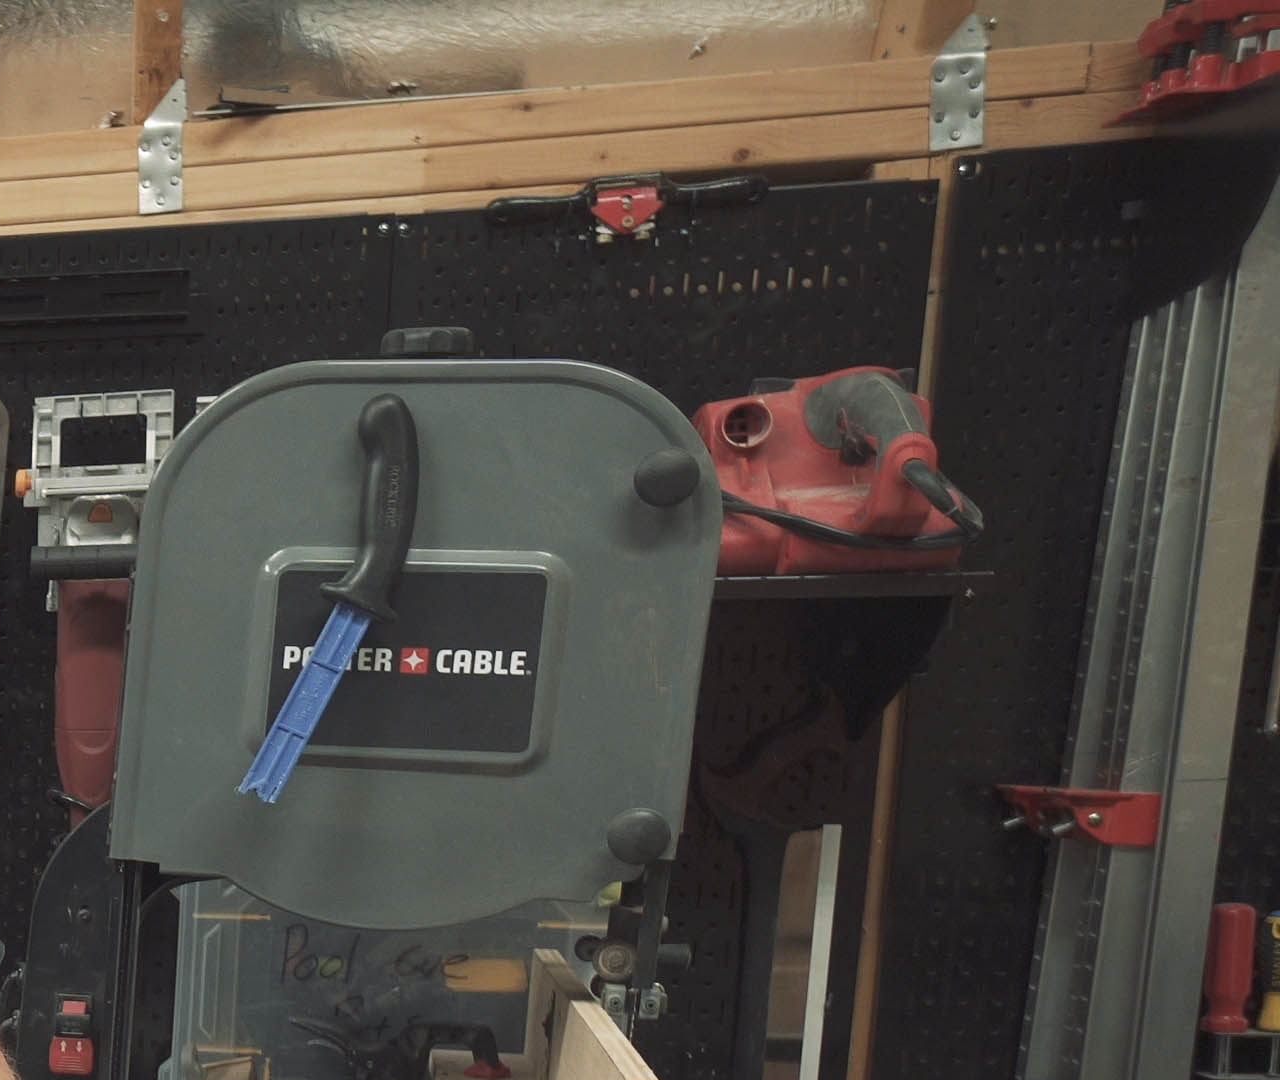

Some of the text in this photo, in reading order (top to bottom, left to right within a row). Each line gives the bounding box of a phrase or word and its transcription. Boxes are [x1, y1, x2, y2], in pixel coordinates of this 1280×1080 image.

[282, 645, 528, 675] PER CABLE
[280, 922, 361, 985] Pool
